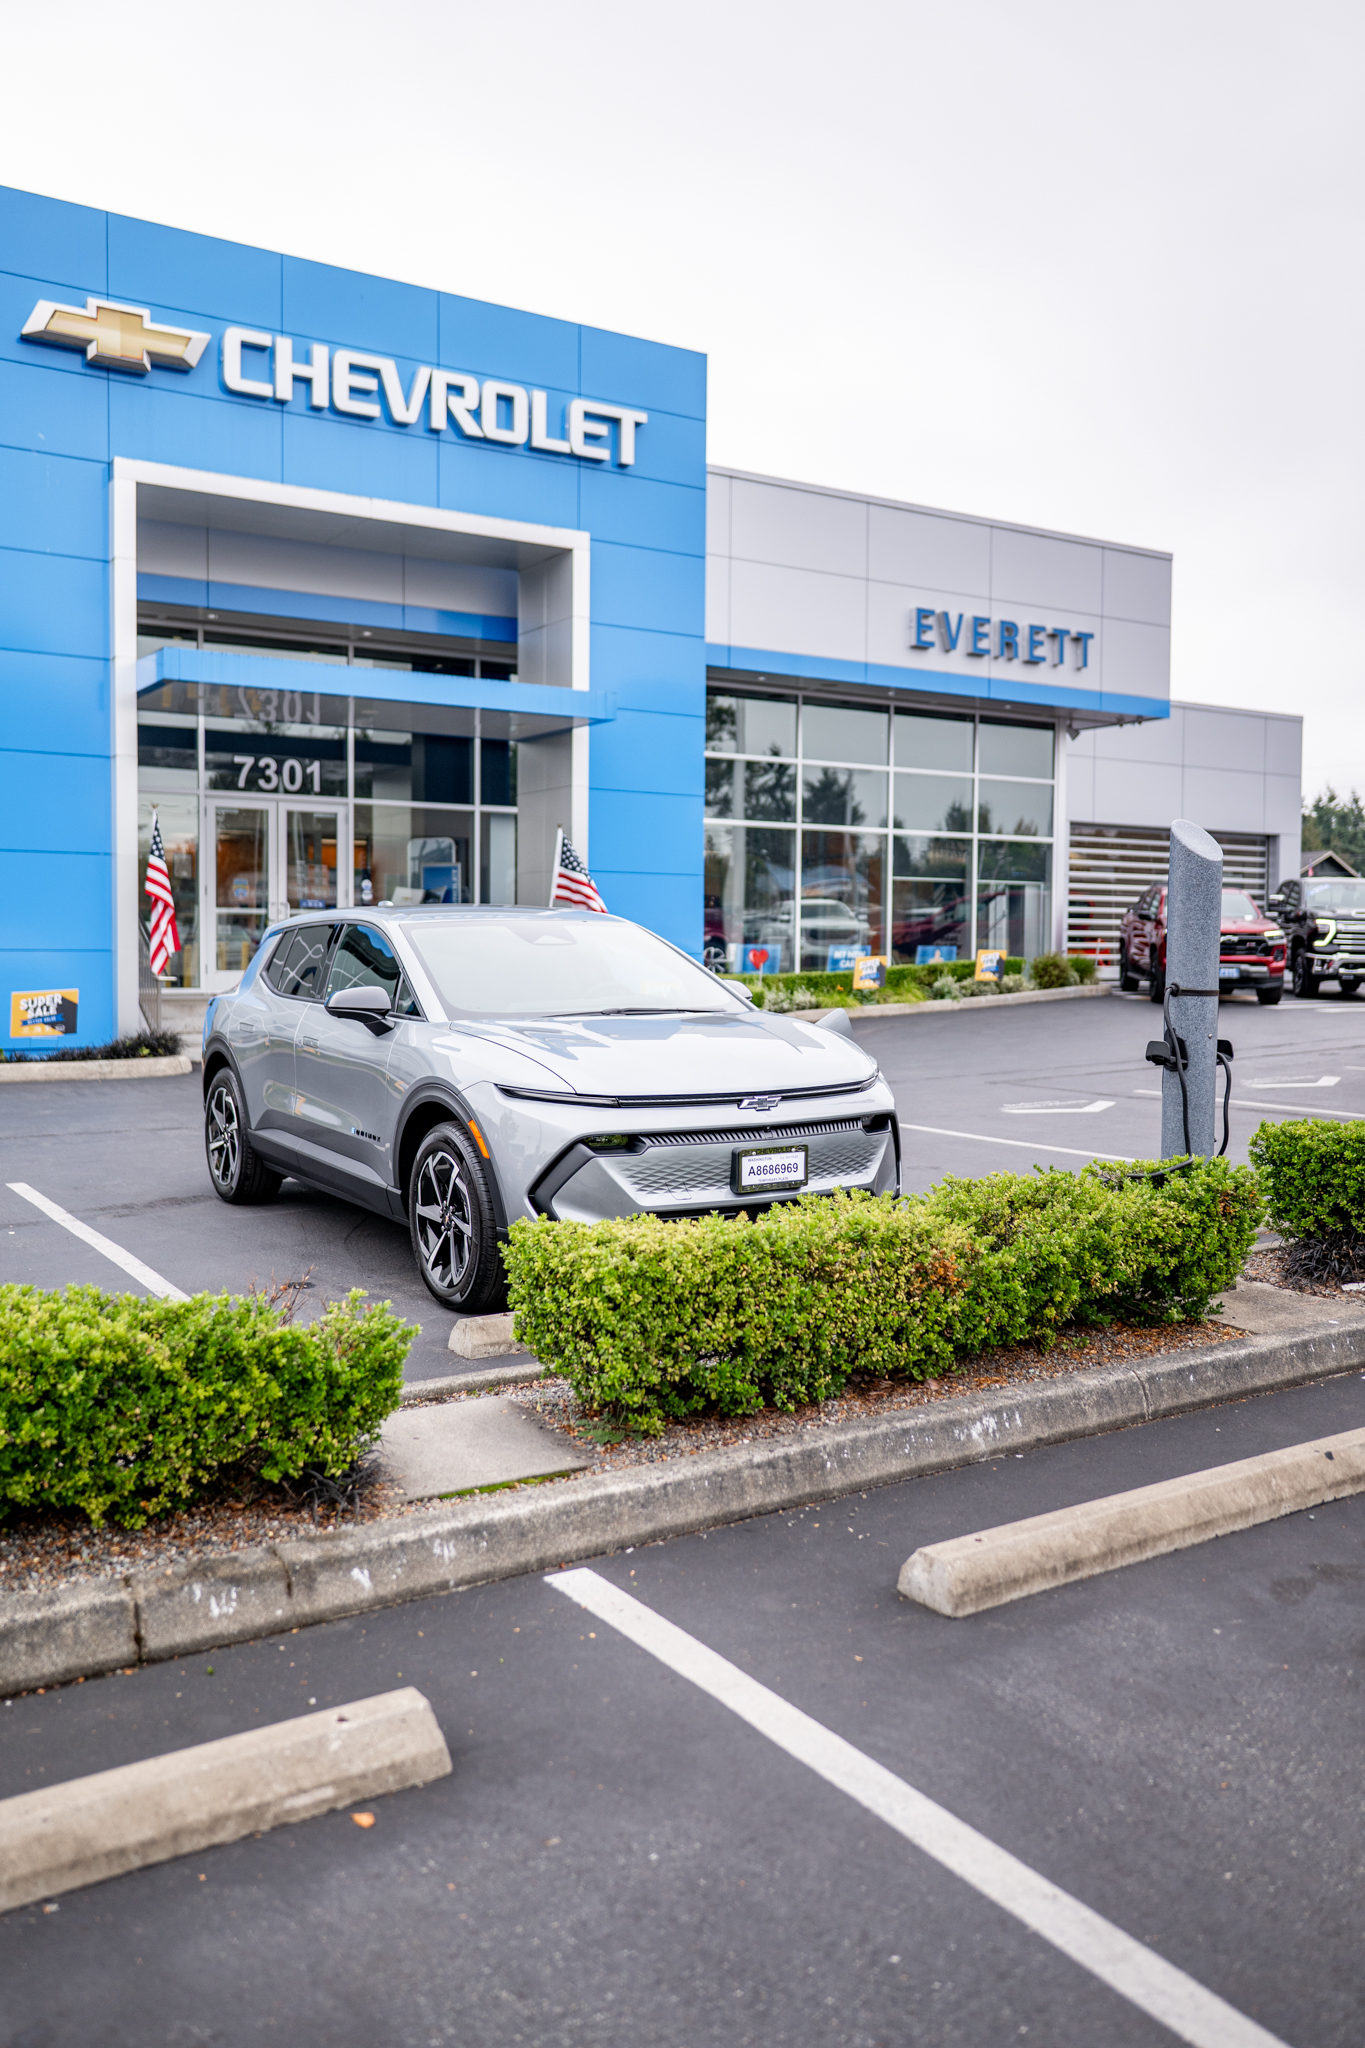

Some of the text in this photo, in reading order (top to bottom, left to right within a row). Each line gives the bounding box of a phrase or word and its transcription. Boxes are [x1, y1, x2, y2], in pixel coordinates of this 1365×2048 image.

[221, 326, 648, 467] CHEVROLET
[911, 607, 1094, 669] EVERETT
[233, 755, 321, 794] 7301
[833, 950, 866, 960] MY NEW
[19, 993, 63, 1011] SUPER
[27, 1004, 57, 1019] SALE
[748, 1163, 798, 1176] A8686969
